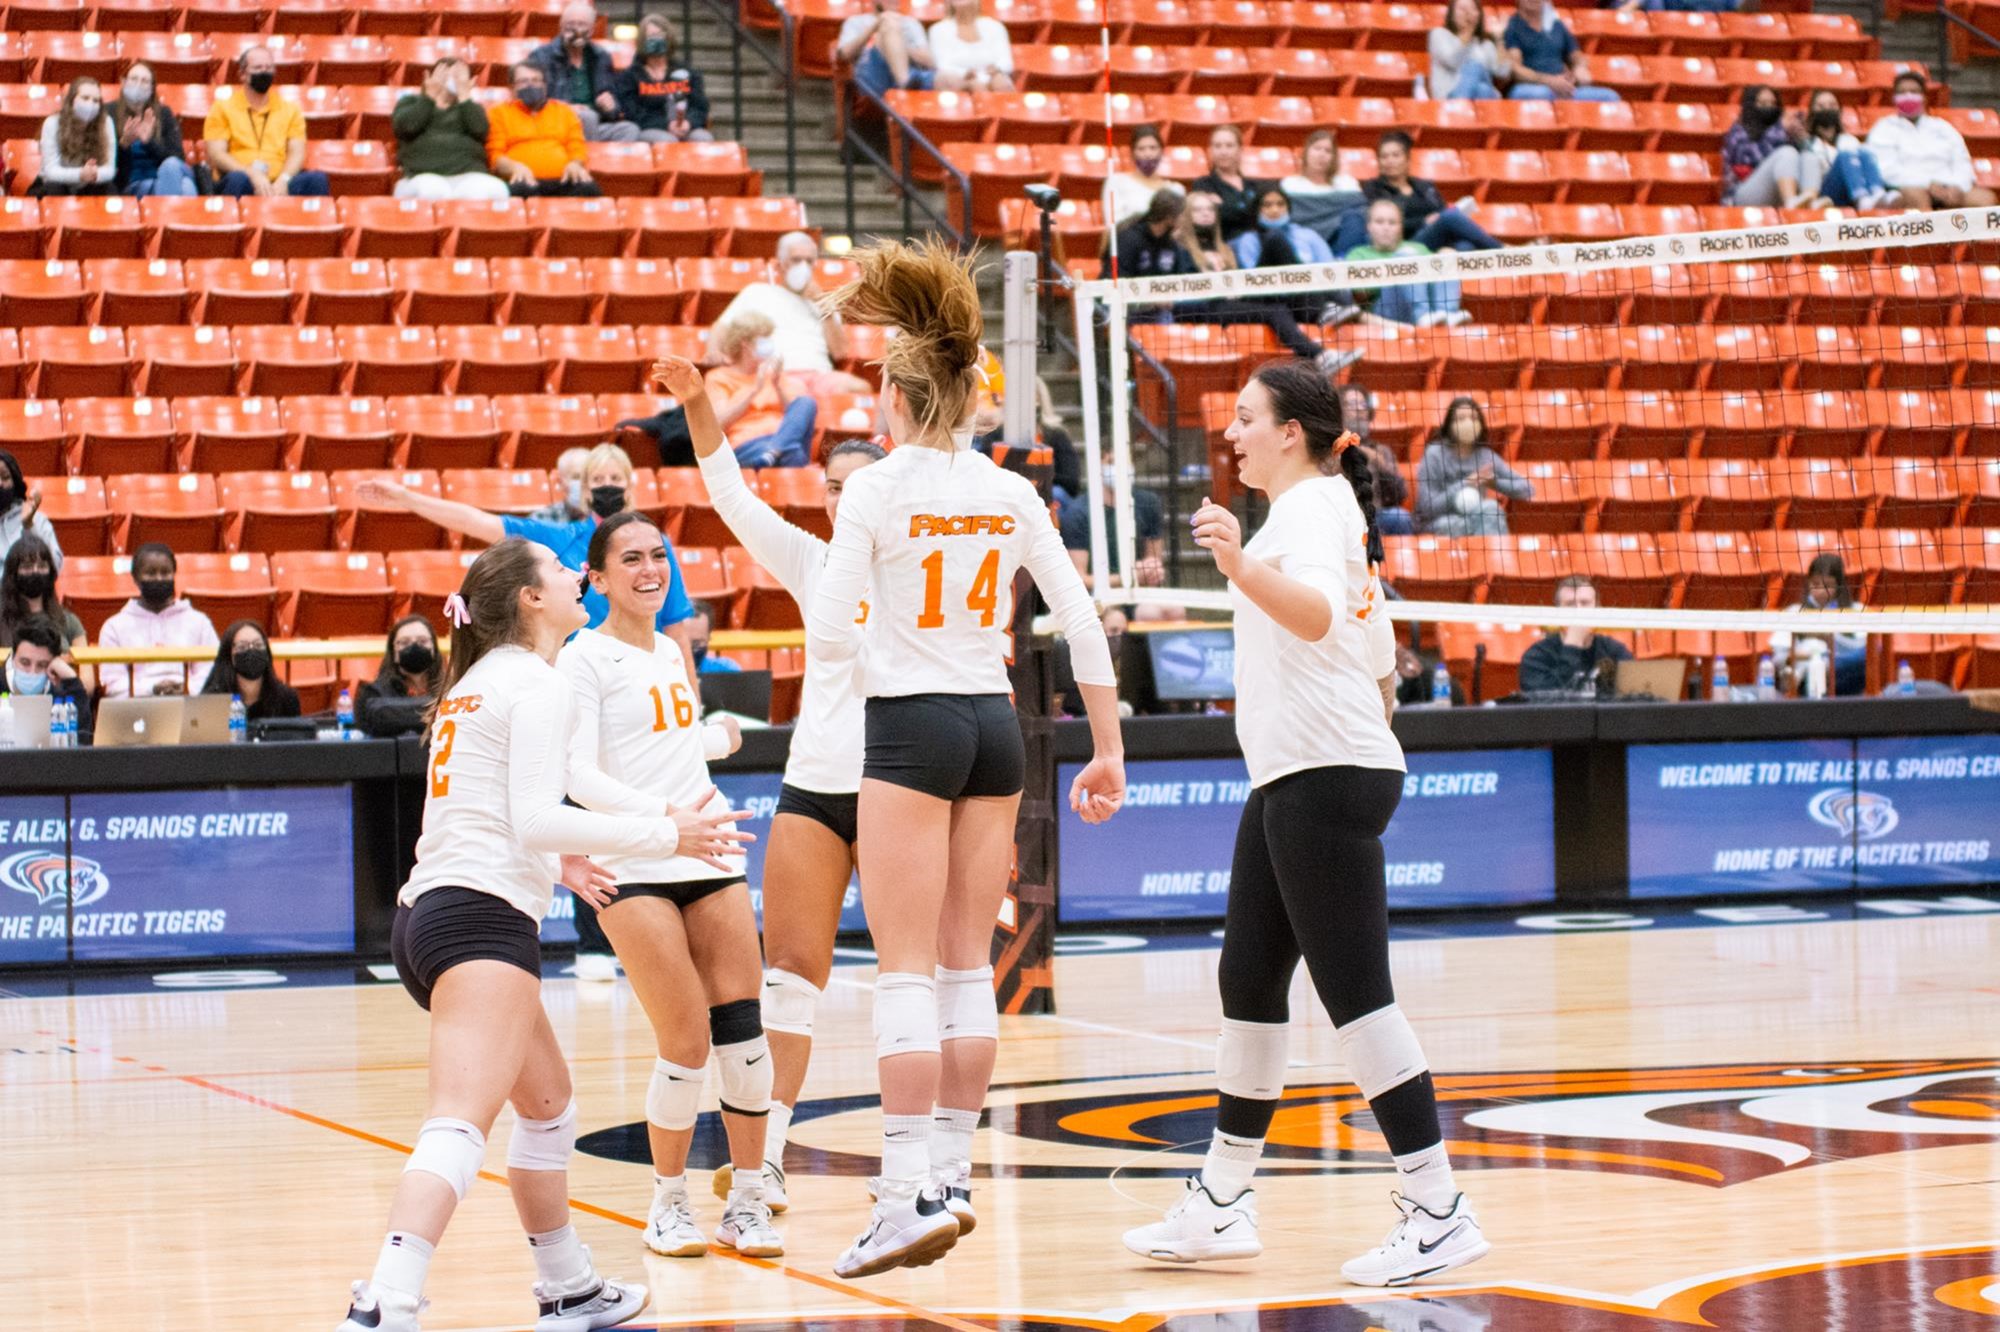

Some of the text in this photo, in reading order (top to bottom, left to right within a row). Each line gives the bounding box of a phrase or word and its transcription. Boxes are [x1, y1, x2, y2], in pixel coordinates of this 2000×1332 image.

[1700, 232, 1789, 253] PACIFIC TIGERS
[1838, 223, 1885, 240] PACIFIC
[1347, 265, 1382, 280] PACIFIC
[1457, 253, 1533, 271] PACIFIC TIGERS
[1278, 270, 1312, 285] TIGERS
[909, 513, 1016, 538] PACIFIC
[917, 549, 1001, 629] 14
[648, 682, 693, 732] 16
[431, 719, 456, 798] 2
[1421, 772, 1498, 795] CENTER
[1660, 764, 1754, 787] WELCOME
[1758, 763, 1782, 783] TO
[1785, 761, 1821, 783] THE
[1821, 760, 1873, 782] ALEX
[1875, 759, 1893, 780] G.
[1898, 756, 1969, 779] SPANOS
[1123, 783, 1182, 806] COME
[1187, 782, 1214, 805] TO
[79, 818, 100, 841] G.
[105, 814, 195, 840] SPANOS
[200, 812, 287, 837] CENTER
[1714, 841, 1991, 872] HOME OF THE PACIFIC TIGERS
[1140, 873, 1204, 895] HOME
[36, 912, 138, 938] PACIFIC
[143, 909, 226, 934] TIGERS
